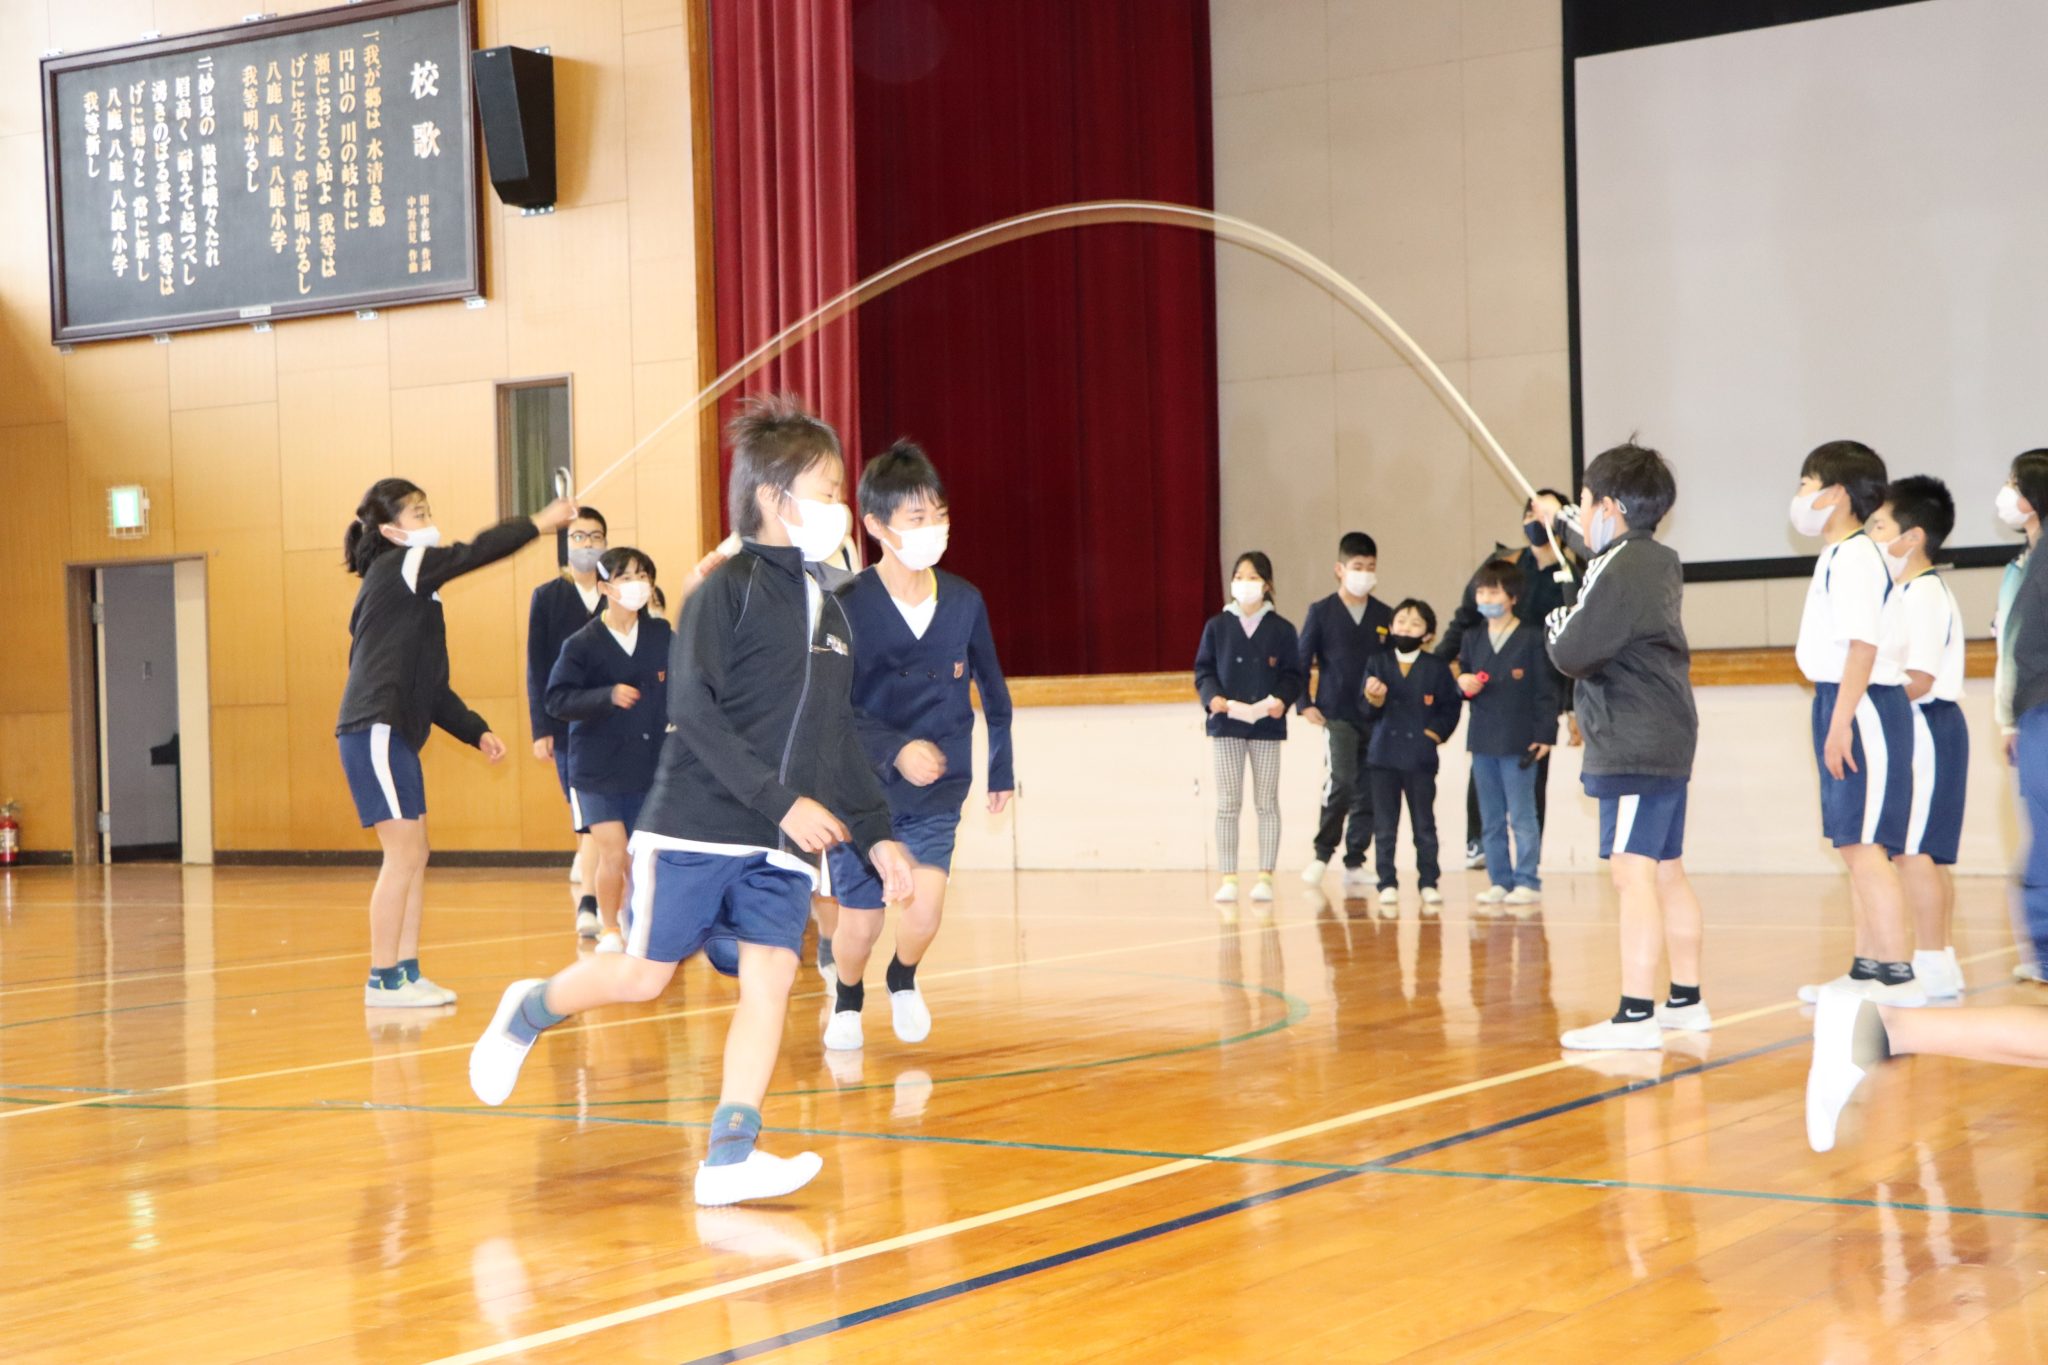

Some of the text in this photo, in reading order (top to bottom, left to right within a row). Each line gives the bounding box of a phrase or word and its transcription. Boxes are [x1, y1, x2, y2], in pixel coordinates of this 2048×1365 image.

[338, 48, 356, 113] 円山の
[410, 61, 441, 158] 校歌
[83, 91, 102, 177] 我等新し
[241, 65, 260, 192] 我等明かるし
[265, 61, 288, 253] 八鹿 八鹿 八鹿小学
[156, 232, 175, 295] 我等は
[318, 213, 337, 277] 我等は
